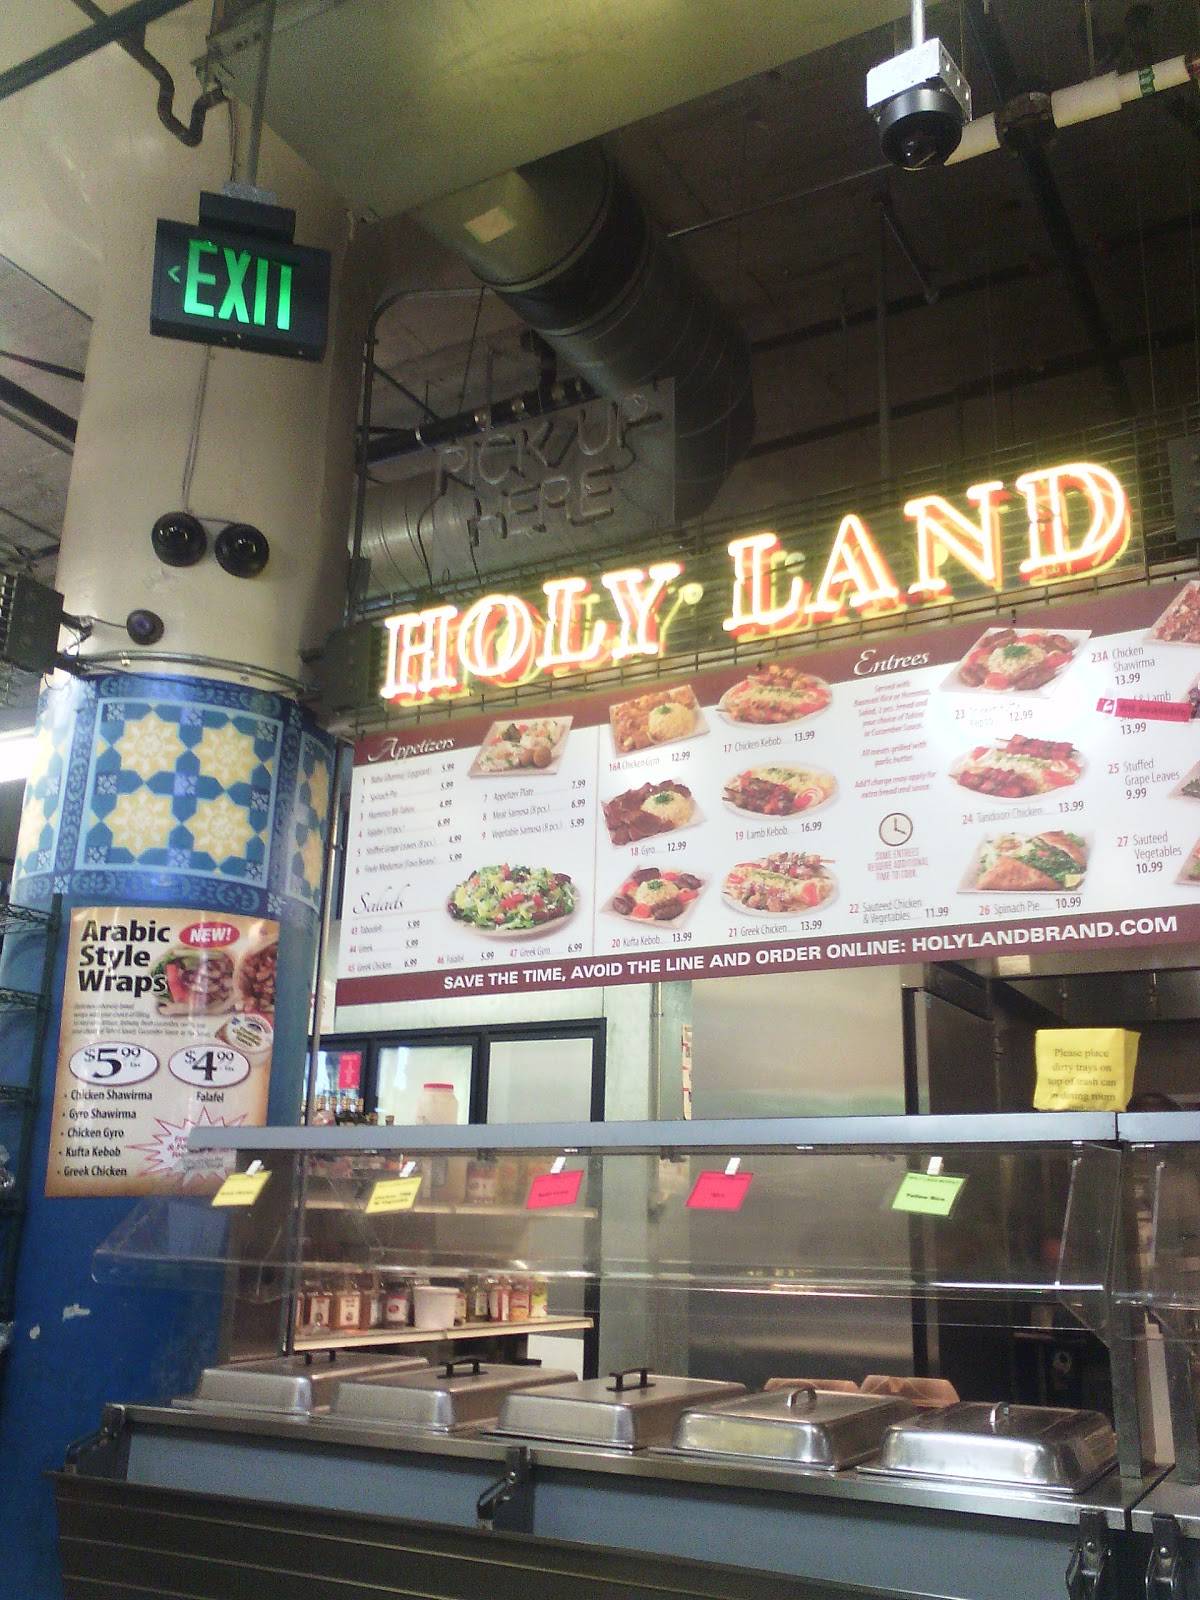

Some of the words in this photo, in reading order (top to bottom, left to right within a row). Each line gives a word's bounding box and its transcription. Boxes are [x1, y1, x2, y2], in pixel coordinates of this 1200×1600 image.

[183, 239, 293, 331] EXIT
[380, 562, 684, 703] HOLY
[724, 462, 1132, 640] LAND
[1091, 651, 1108, 662] 23A
[1112, 647, 1143, 659] Chicken
[853, 649, 930, 677] Entrees
[1113, 659, 1155, 672] Shawirma
[1115, 673, 1140, 685] 13.99
[1010, 710, 1033, 721] 12.99
[1121, 722, 1146, 735] 13.99
[724, 743, 732, 753] 17
[735, 739, 759, 752] Chicken
[761, 736, 782, 748] Kebob
[794, 730, 815, 742] 13.99
[368, 737, 455, 762] Appetizers
[622, 757, 644, 770] Chicken
[671, 751, 691, 762] 12.99
[1108, 763, 1119, 774] 25
[1124, 758, 1154, 772] Stuffed
[1125, 775, 1149, 788] Grape
[1151, 771, 1179, 783] Leaves
[1126, 788, 1146, 799] 9.99
[1012, 807, 1041, 818] Chicken
[1059, 801, 1084, 812] 13.99
[735, 831, 744, 841] 19
[747, 828, 765, 840] Lamb
[767, 826, 788, 837] Kebob
[801, 821, 822, 832] 16.99
[1117, 836, 1128, 847] 27
[1133, 832, 1168, 846] Sauteed
[630, 847, 639, 857] 18
[667, 841, 687, 852] 12.99
[1135, 846, 1182, 860] Vegetables
[1136, 861, 1163, 874] 10.99
[850, 905, 859, 914] 22
[863, 900, 892, 912] Sauteed
[894, 898, 921, 908] Chicken
[980, 905, 989, 915] 26
[994, 902, 1026, 915] Spinach
[1028, 901, 1040, 911] Pie
[1056, 897, 1081, 909] 10.99
[871, 911, 910, 925] Vegetables
[925, 907, 948, 919] 11.99
[81, 920, 171, 943] Arabic
[189, 926, 232, 942] NEW!
[729, 927, 737, 937] 21
[740, 925, 760, 938] Greek
[762, 922, 787, 935] Chicken
[801, 920, 822, 931] 13.99
[612, 938, 621, 948] 20
[623, 936, 639, 948] Kufta
[641, 934, 660, 946] Kebob
[672, 932, 692, 943] 13.99
[444, 974, 484, 990] SAVE
[488, 971, 518, 986] THE
[522, 968, 566, 983] TIME,
[571, 963, 623, 980] AVOID
[627, 959, 660, 974] THE
[666, 955, 704, 972] LINE
[709, 951, 751, 968] AND
[756, 945, 821, 965] ORDER
[826, 939, 906, 959] ONLINE:
[912, 915, 1178, 952] HOLYLANDBRAND.COM
[568, 943, 583, 953] 6.99
[79, 945, 150, 972] Style
[480, 951, 494, 961] 5.99
[78, 970, 167, 998] Wraps
[1054, 1048, 1082, 1057] Please
[1085, 1048, 1109, 1059] place
[1052, 1063, 1073, 1073] dirty
[1076, 1063, 1098, 1073] trays
[1048, 1078, 1062, 1087] top
[1064, 1078, 1074, 1086] of
[71, 1089, 105, 1100] Chicken
[107, 1090, 152, 1101] Shawirma
[196, 1091, 224, 1103] Falafel
[69, 1110, 88, 1121] Gyro
[91, 1109, 137, 1119] Shawirma
[67, 1128, 101, 1138] Chicken
[103, 1128, 124, 1139] Gyro
[65, 1147, 90, 1157] Kufta
[92, 1147, 121, 1157] Kebob
[64, 1166, 88, 1176] Greek
[91, 1166, 127, 1176] Chicken
